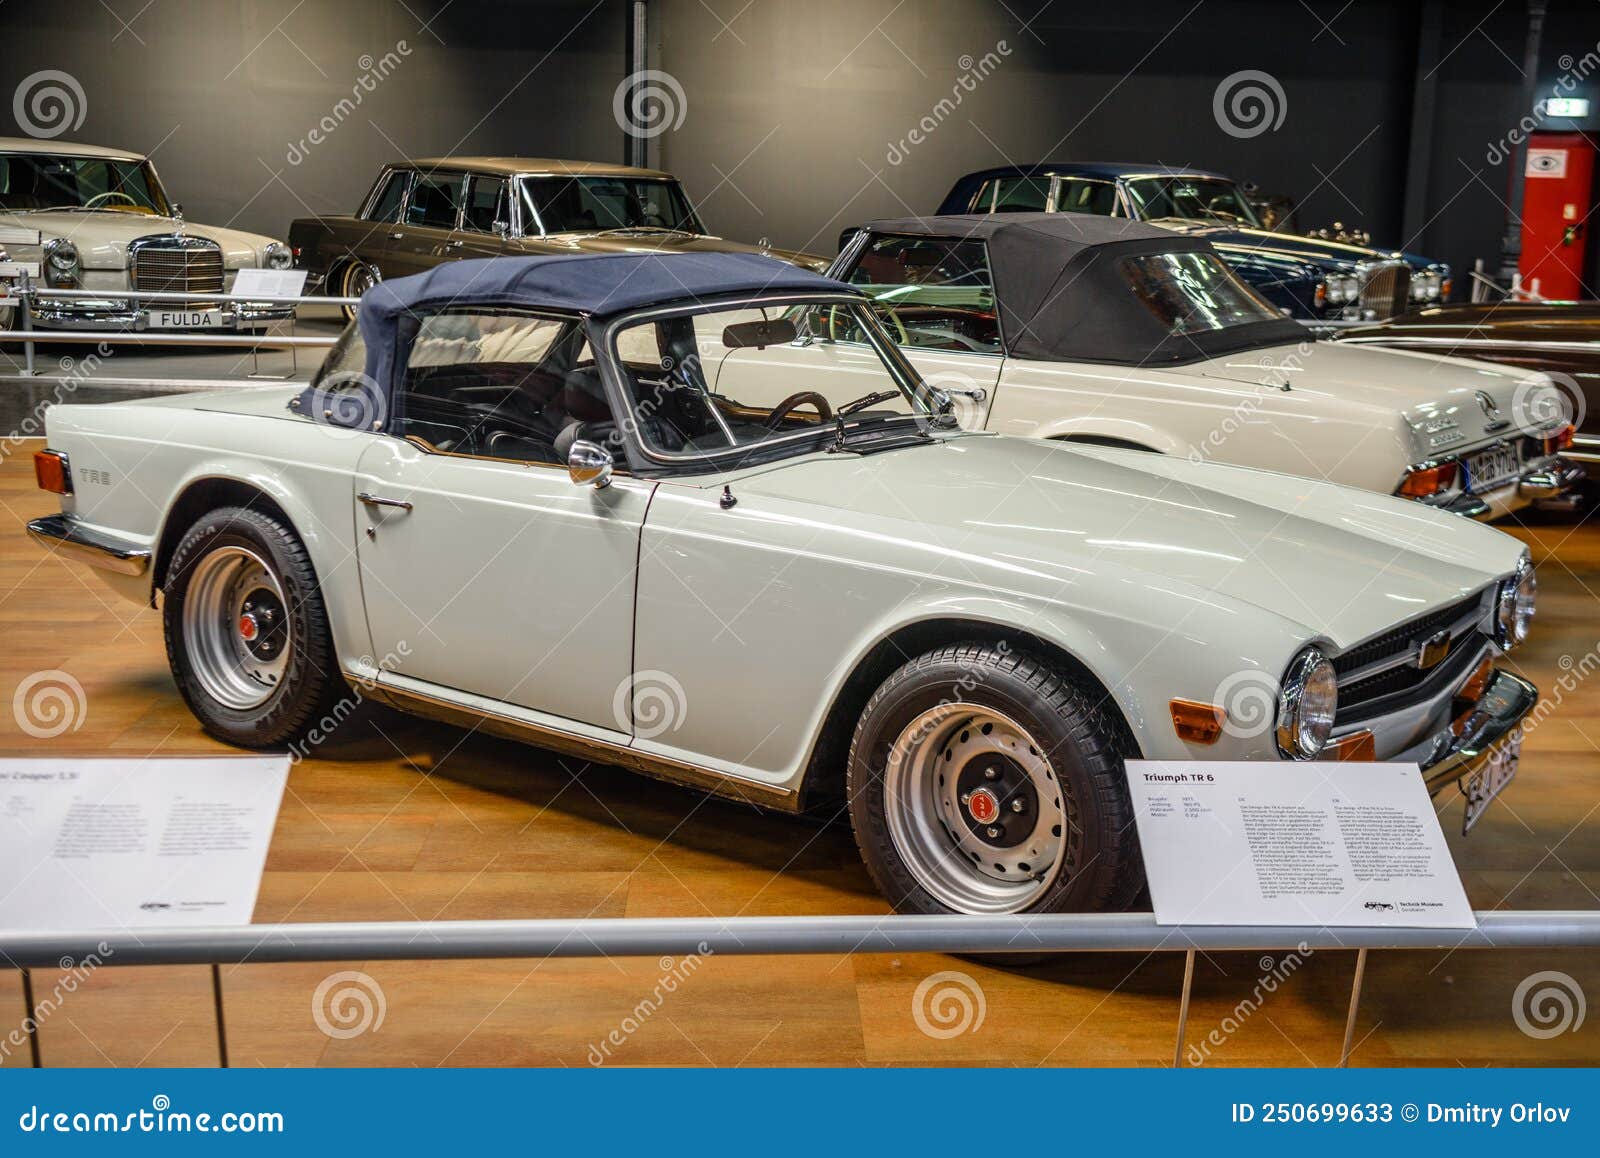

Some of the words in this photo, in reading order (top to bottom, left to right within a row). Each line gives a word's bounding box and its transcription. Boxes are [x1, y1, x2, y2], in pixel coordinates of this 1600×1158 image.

[161, 313, 212, 326] FULDA
[1143, 773, 1188, 783] Triumph
[1190, 774, 1204, 782] TR
[1206, 774, 1215, 782] 6
